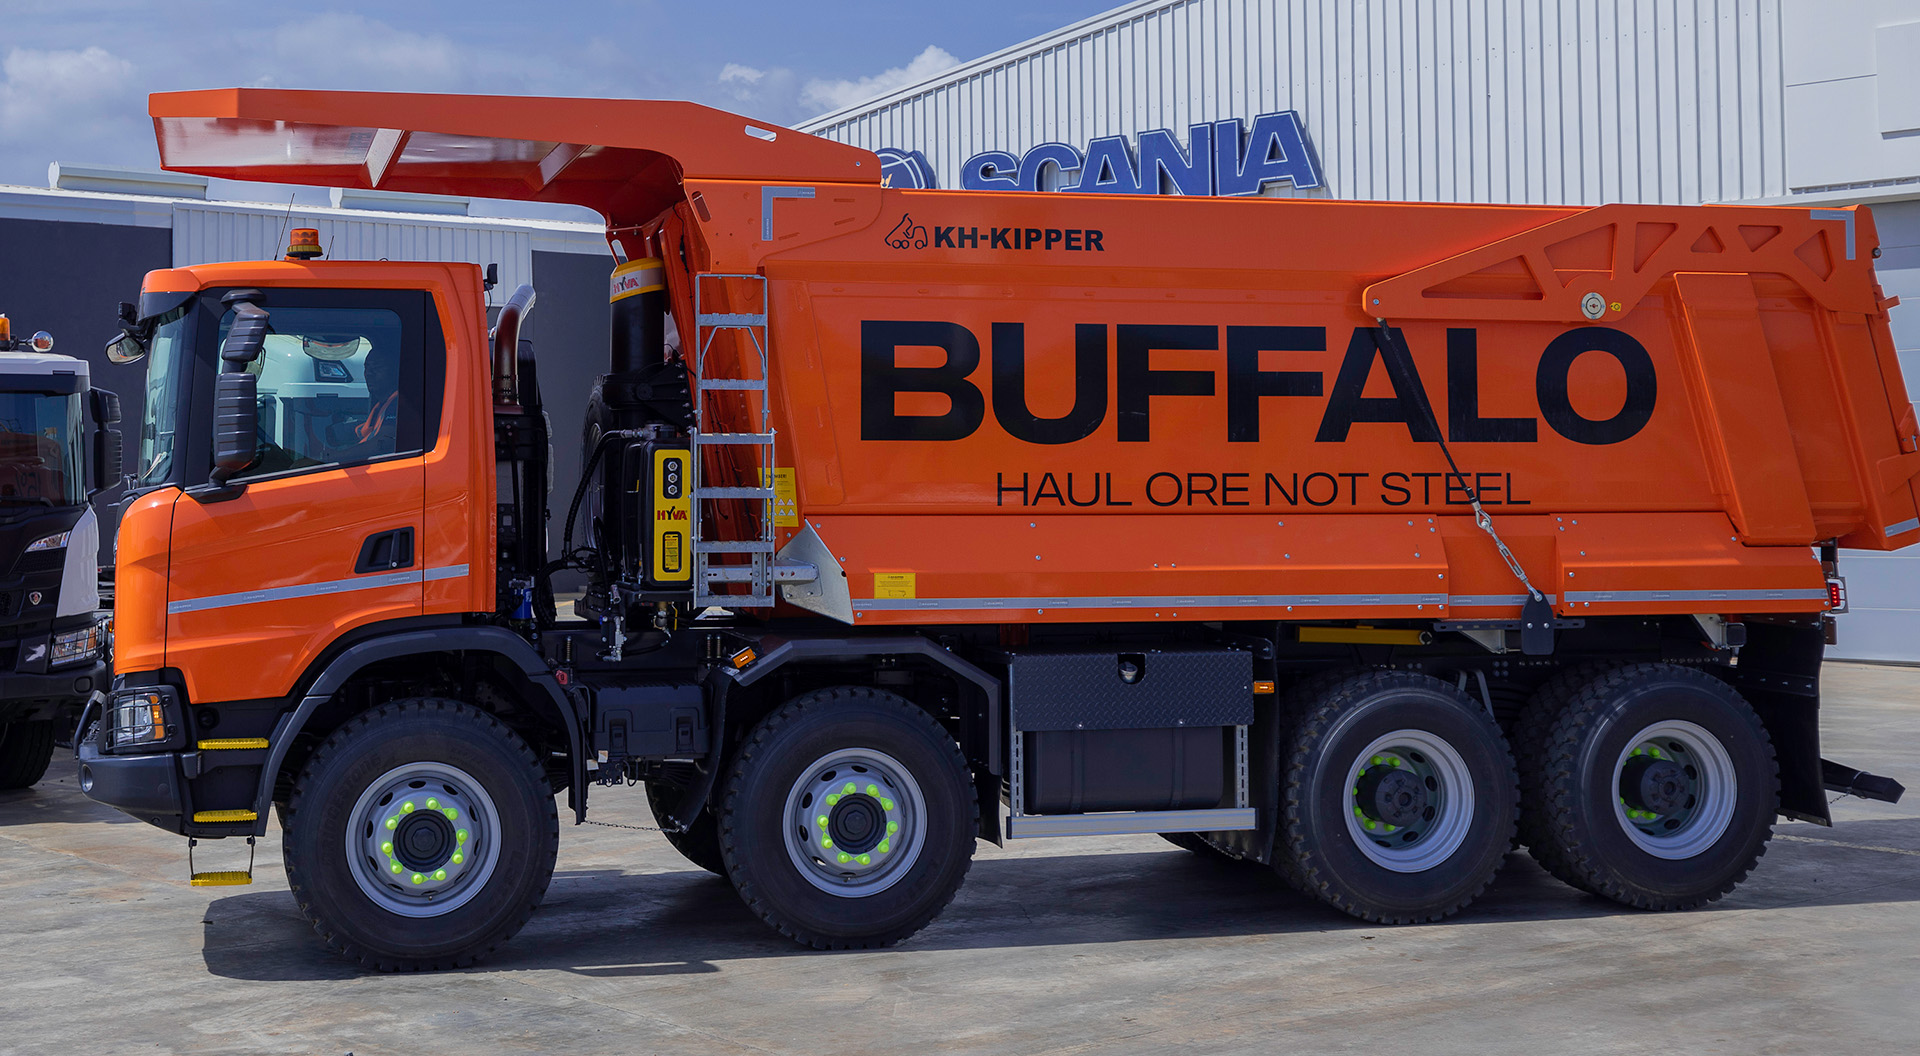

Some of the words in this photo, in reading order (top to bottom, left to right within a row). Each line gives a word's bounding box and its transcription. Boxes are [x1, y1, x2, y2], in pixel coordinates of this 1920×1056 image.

[960, 109, 1322, 197] SCANIA
[934, 226, 1105, 251] KH-KIPPER
[613, 276, 639, 293] HYVA
[860, 320, 1657, 446] BUFFALO
[997, 472, 1132, 506] HAUL
[1146, 472, 1250, 506] ORE
[1265, 472, 1369, 506] NOT
[1381, 472, 1531, 506] STEEL
[657, 506, 687, 520] HYVA
